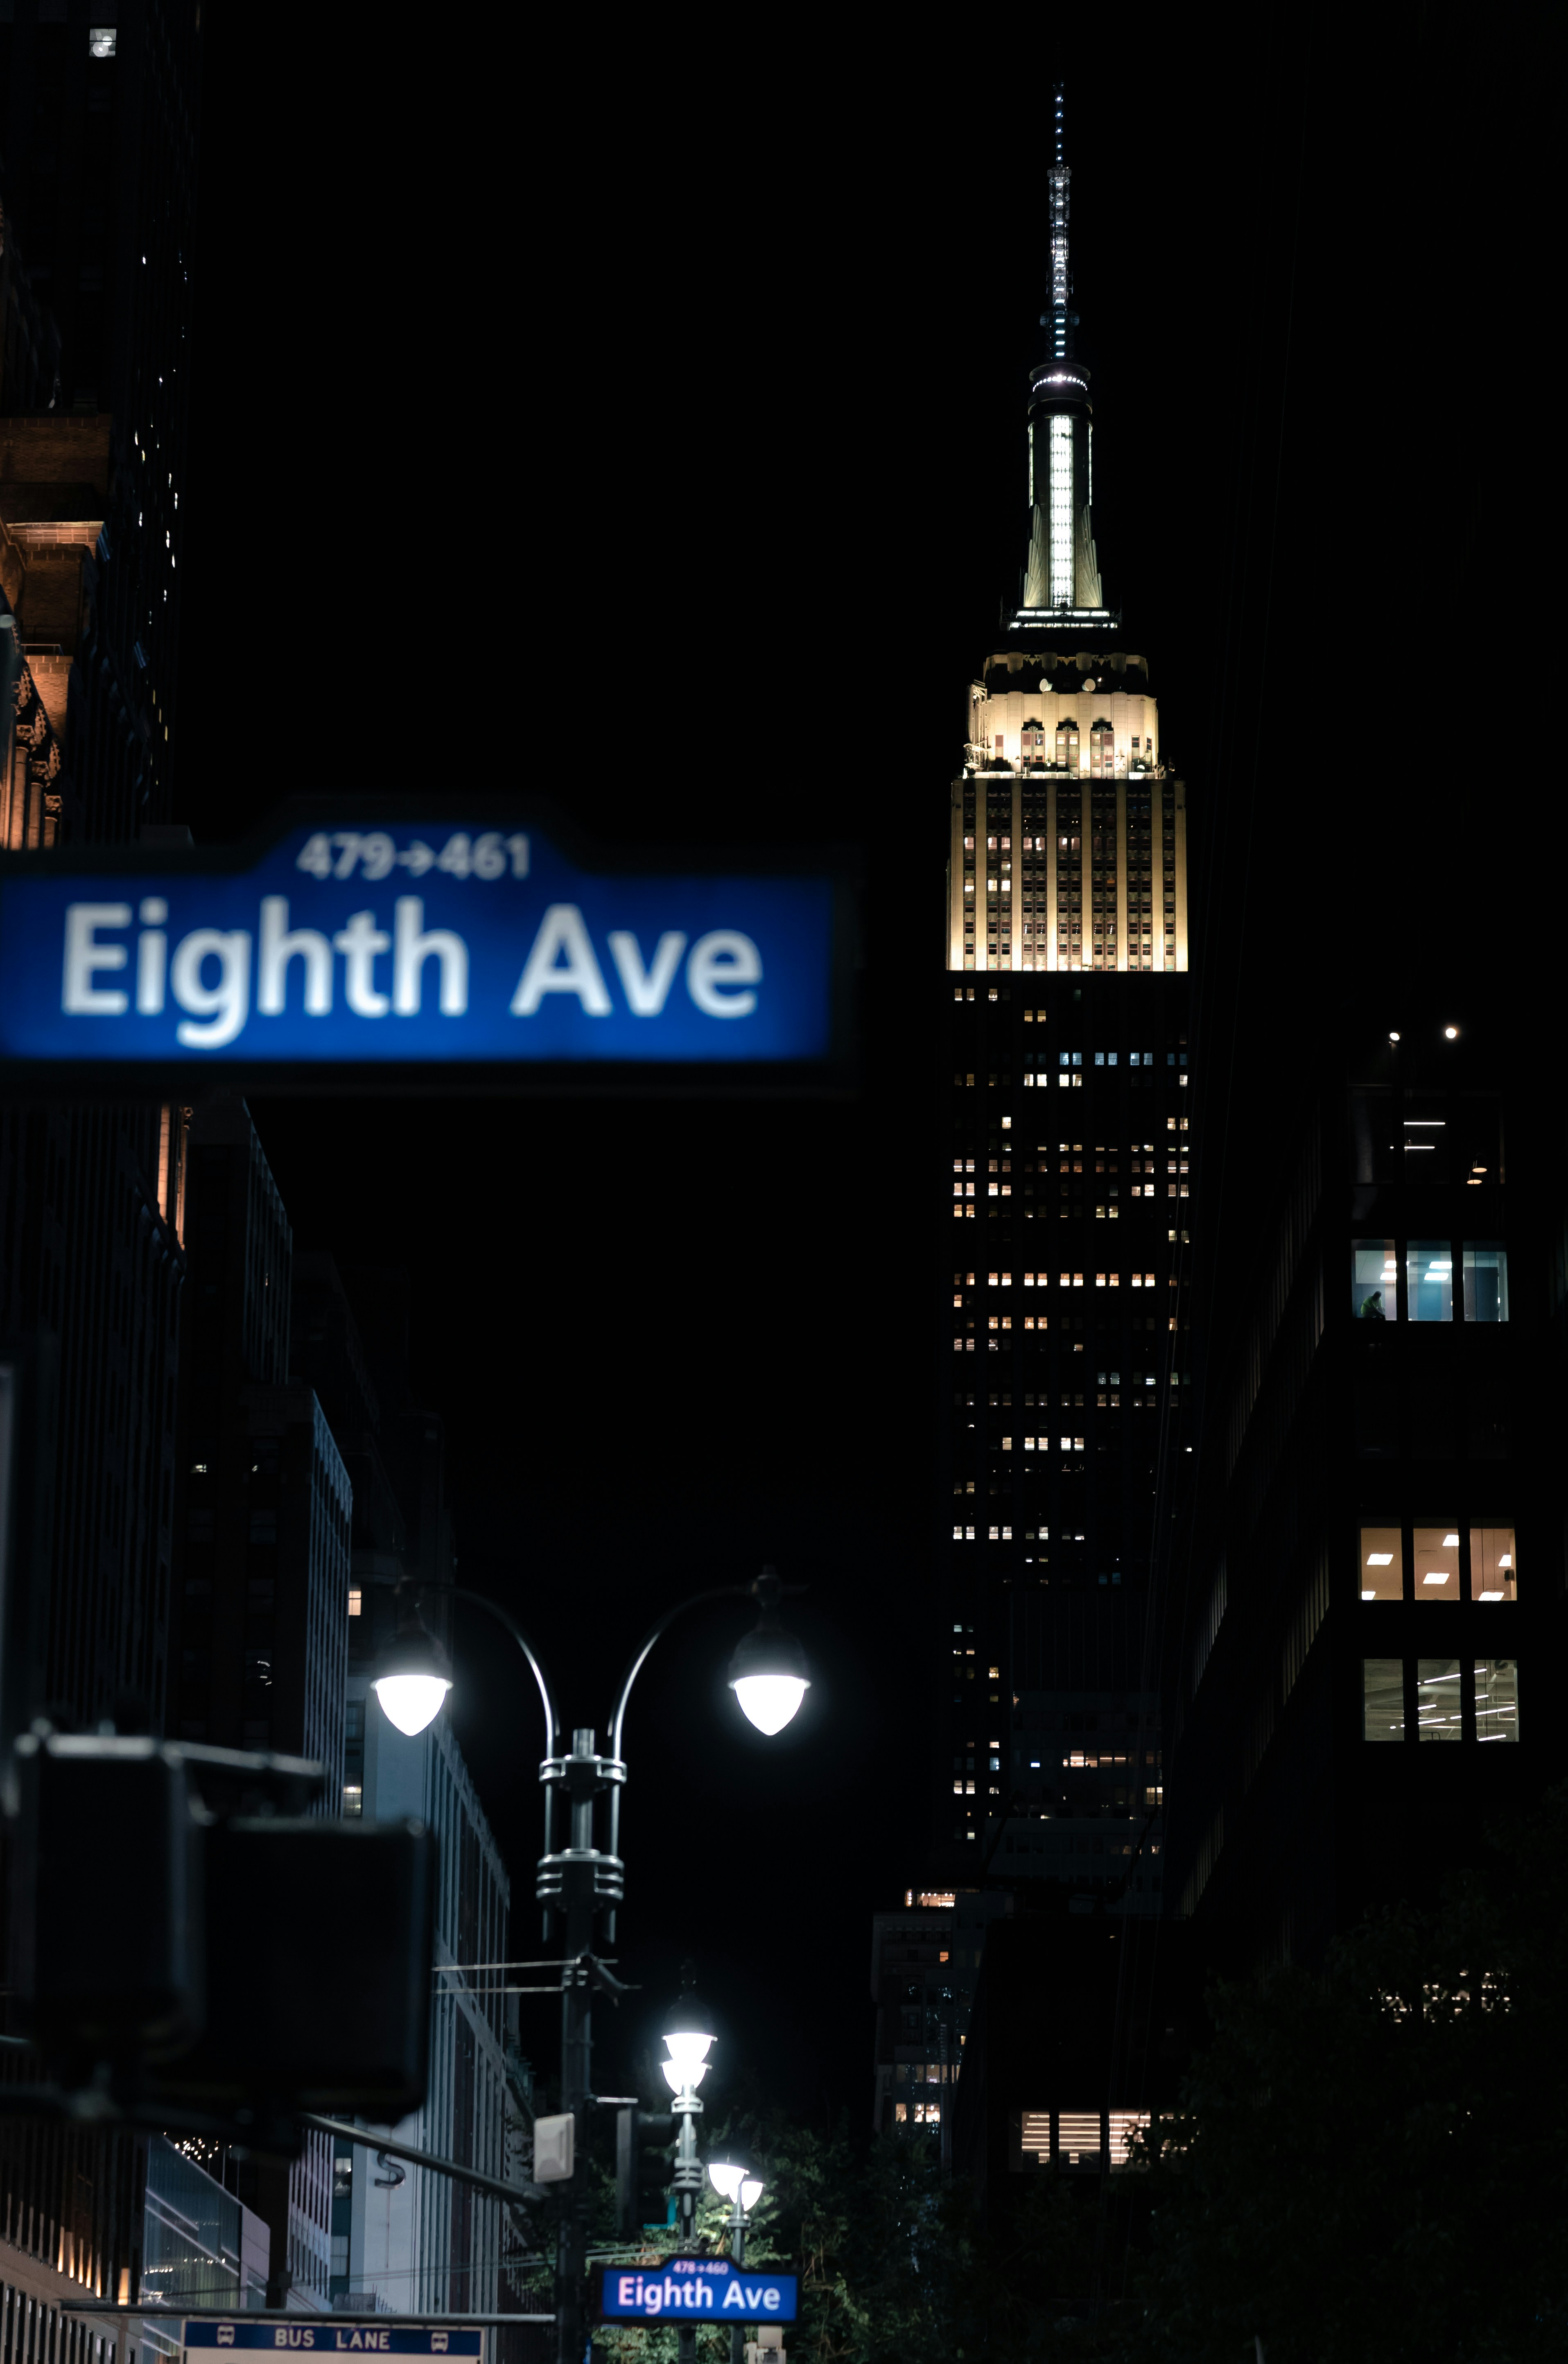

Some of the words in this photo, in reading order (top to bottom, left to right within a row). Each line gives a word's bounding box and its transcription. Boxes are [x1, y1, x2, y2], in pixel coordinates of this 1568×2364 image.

[296, 832, 398, 880] 479
[434, 832, 530, 880] 461
[61, 896, 469, 1050] Eighth
[509, 903, 763, 1019] Ave
[618, 2276, 713, 2315] Eighth
[722, 2280, 780, 2311] Ave
[274, 2328, 315, 2348] BUS
[335, 2330, 390, 2350] LANE
